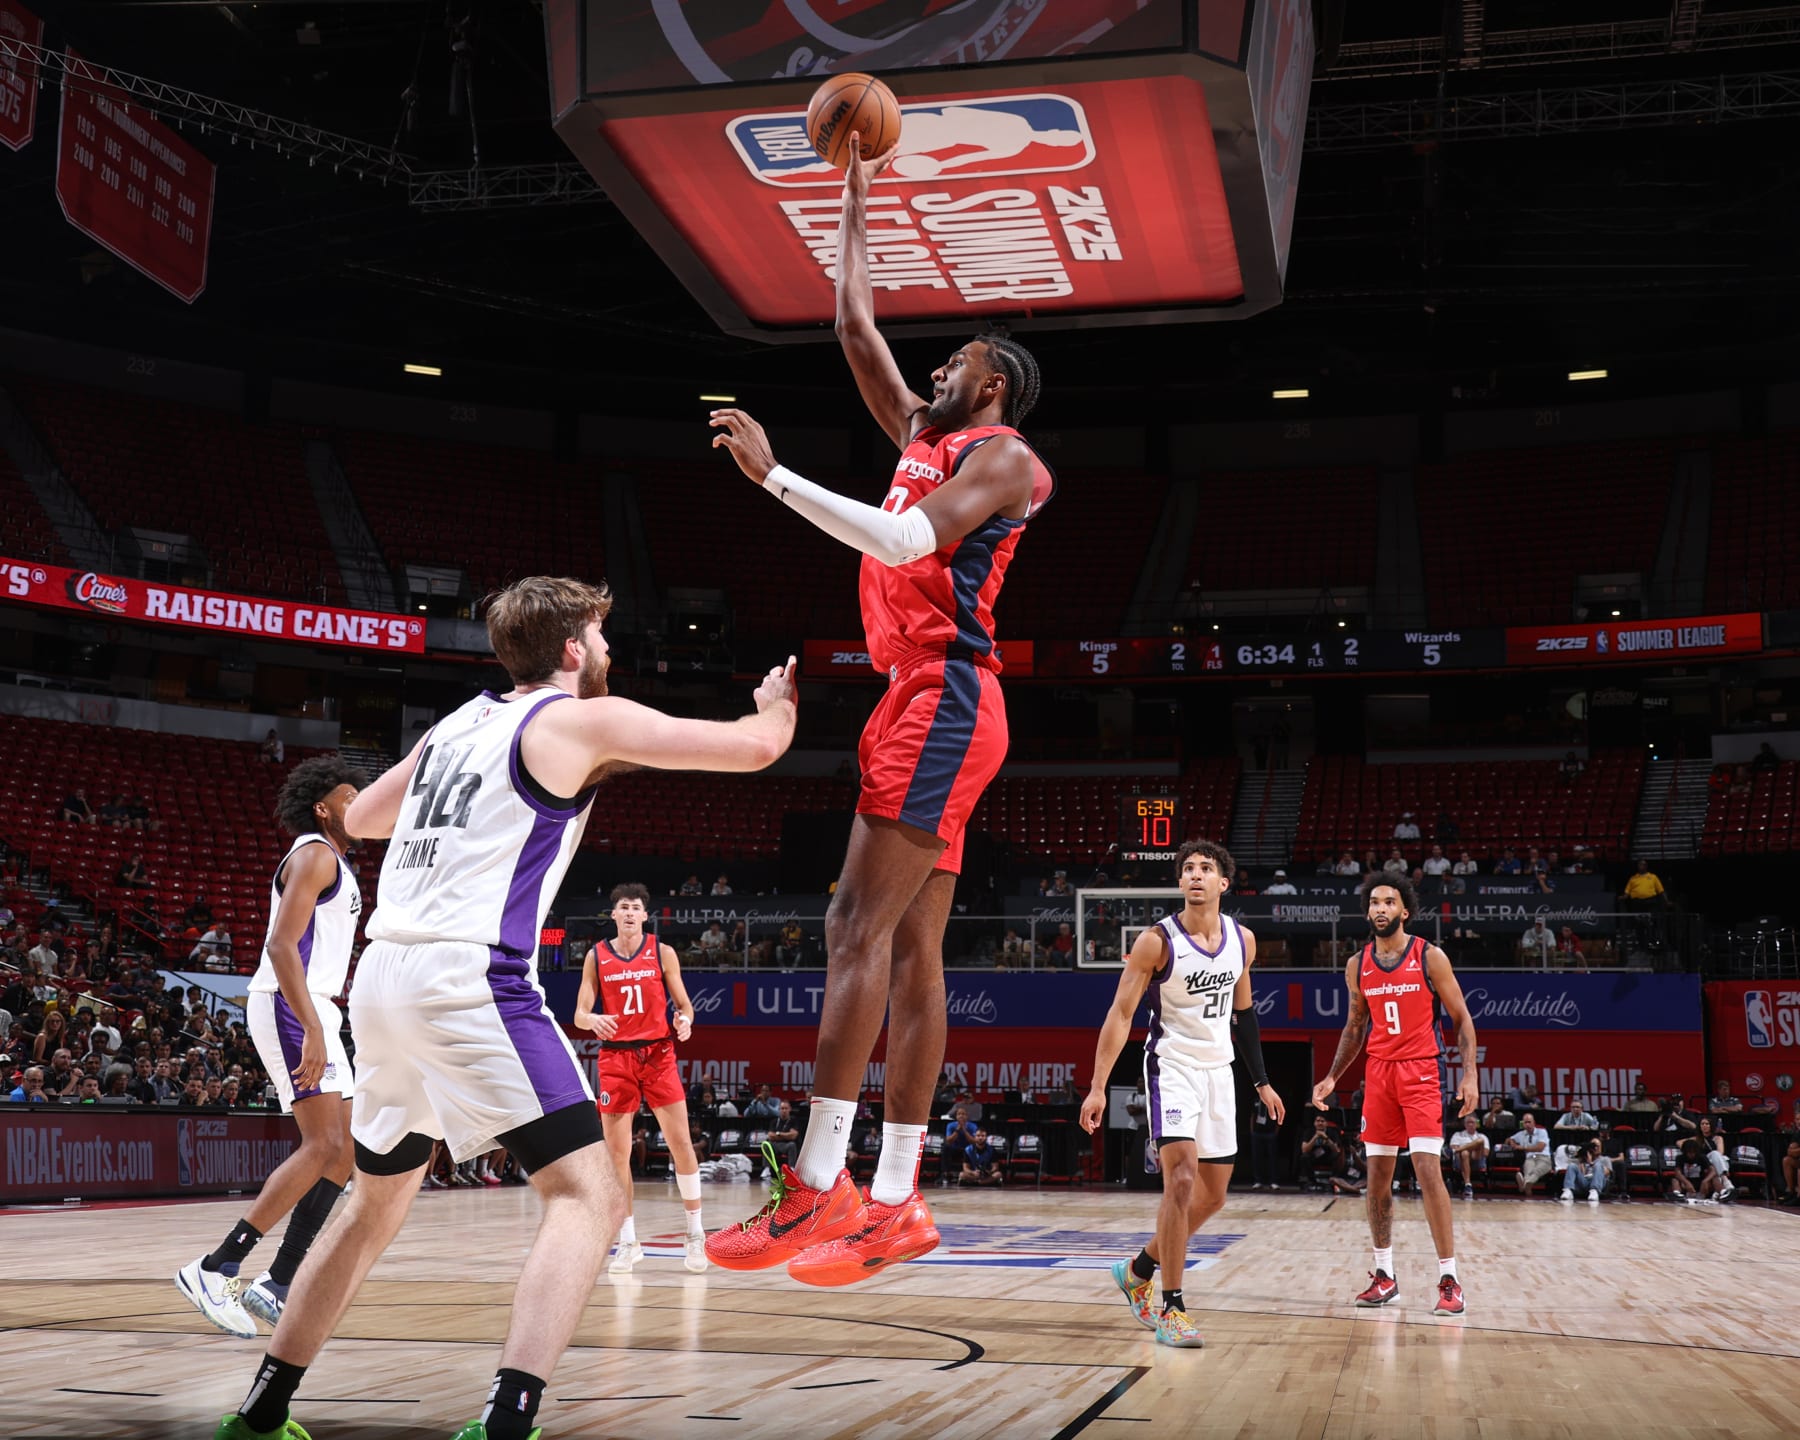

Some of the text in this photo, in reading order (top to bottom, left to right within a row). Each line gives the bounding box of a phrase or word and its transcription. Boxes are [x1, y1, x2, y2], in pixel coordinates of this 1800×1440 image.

[816, 101, 851, 156] Wilson
[750, 125, 818, 162] NBA
[126, 183, 144, 209] 2011
[151, 201, 170, 227] 2012
[1048, 186, 1123, 261] 2K25
[911, 189, 1074, 303] SUMMER
[75, 572, 128, 602] Cane's
[144, 587, 284, 634] RAISING
[1080, 641, 1118, 653] Kings
[1311, 642, 1321, 656] 1
[1344, 638, 1359, 655] 2
[1404, 632, 1461, 643] Wizards
[1536, 625, 1726, 652] 2K25 SUMMER LEAGUE
[832, 652, 872, 664] 2K2
[1092, 653, 1109, 674] 5
[1171, 643, 1185, 661] 2
[1211, 645, 1220, 658] 1
[1237, 644, 1296, 665] 6:34
[1307, 658, 1324, 667] FLS
[1423, 644, 1441, 665] 5
[1207, 660, 1223, 670] FLS
[411, 742, 482, 830] 46
[1137, 800, 1175, 816] 6:34
[1143, 817, 1171, 846] 10
[1137, 852, 1177, 861] TISSOT
[675, 909, 737, 924] ULTRA
[1456, 905, 1528, 921] ULTRA
[604, 970, 656, 983] washington
[1184, 970, 1235, 994] Kings
[620, 984, 645, 1015] 21
[1364, 983, 1421, 997] washington
[758, 987, 824, 1014] ULT
[946, 990, 997, 1024] tside
[1203, 992, 1230, 1018] 20
[1464, 988, 1581, 1026] Courtside
[1385, 1001, 1401, 1035] 9
[975, 1062, 1022, 1094] PLAY
[1543, 1067, 1643, 1111] LEAGUE
[196, 1120, 228, 1137] 2K25
[7, 1127, 153, 1185] NBAEvents.com
[196, 1139, 250, 1184] SUMMER
